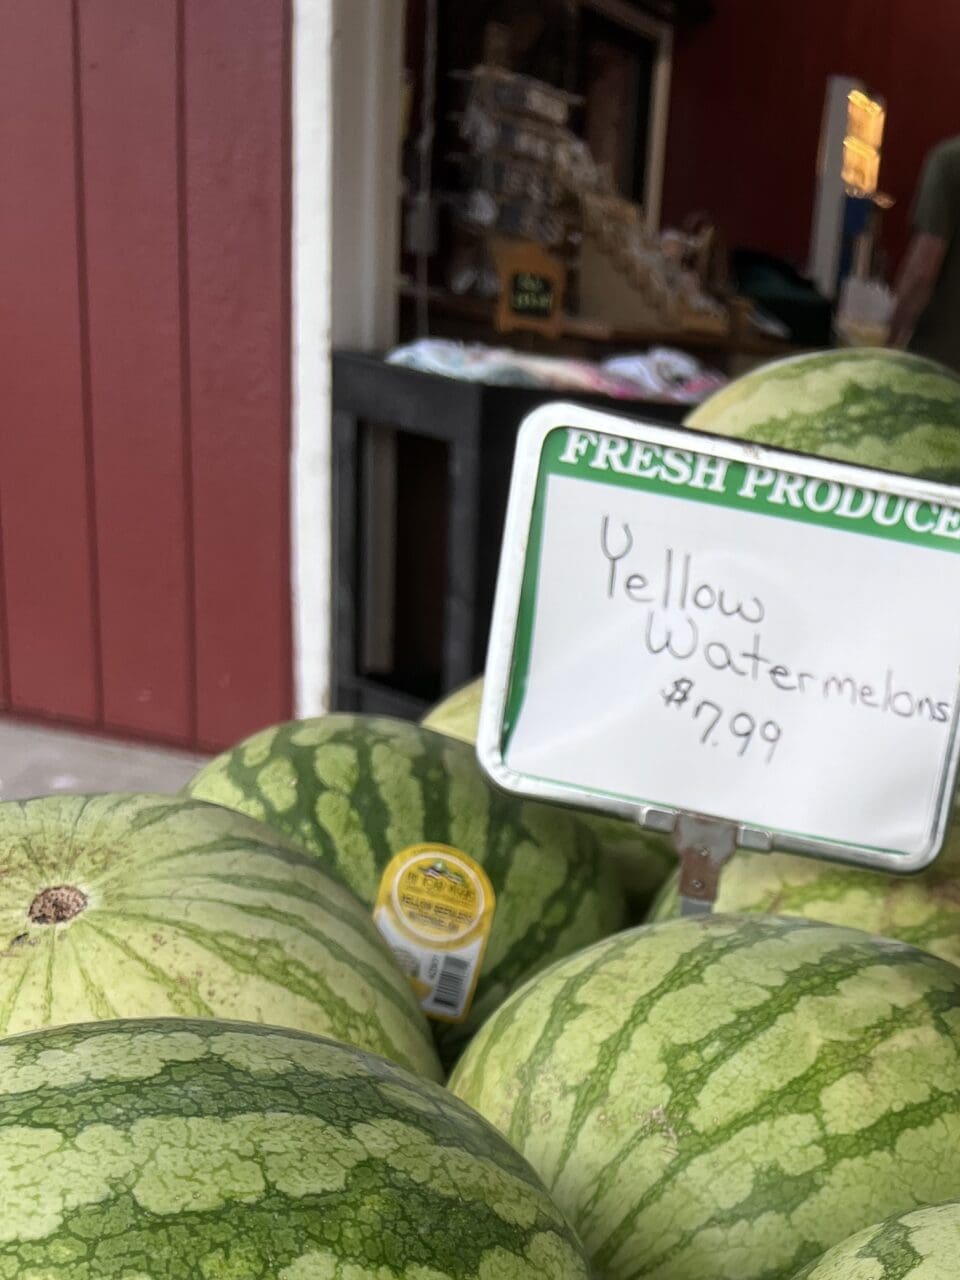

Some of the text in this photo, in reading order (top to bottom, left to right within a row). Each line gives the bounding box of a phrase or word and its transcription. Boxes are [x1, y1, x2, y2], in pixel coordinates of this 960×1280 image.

[559, 428, 726, 493] FRESH
[599, 513, 765, 624] Yellow
[644, 609, 953, 725] Watermelons
[661, 677, 783, 766] $7.99
